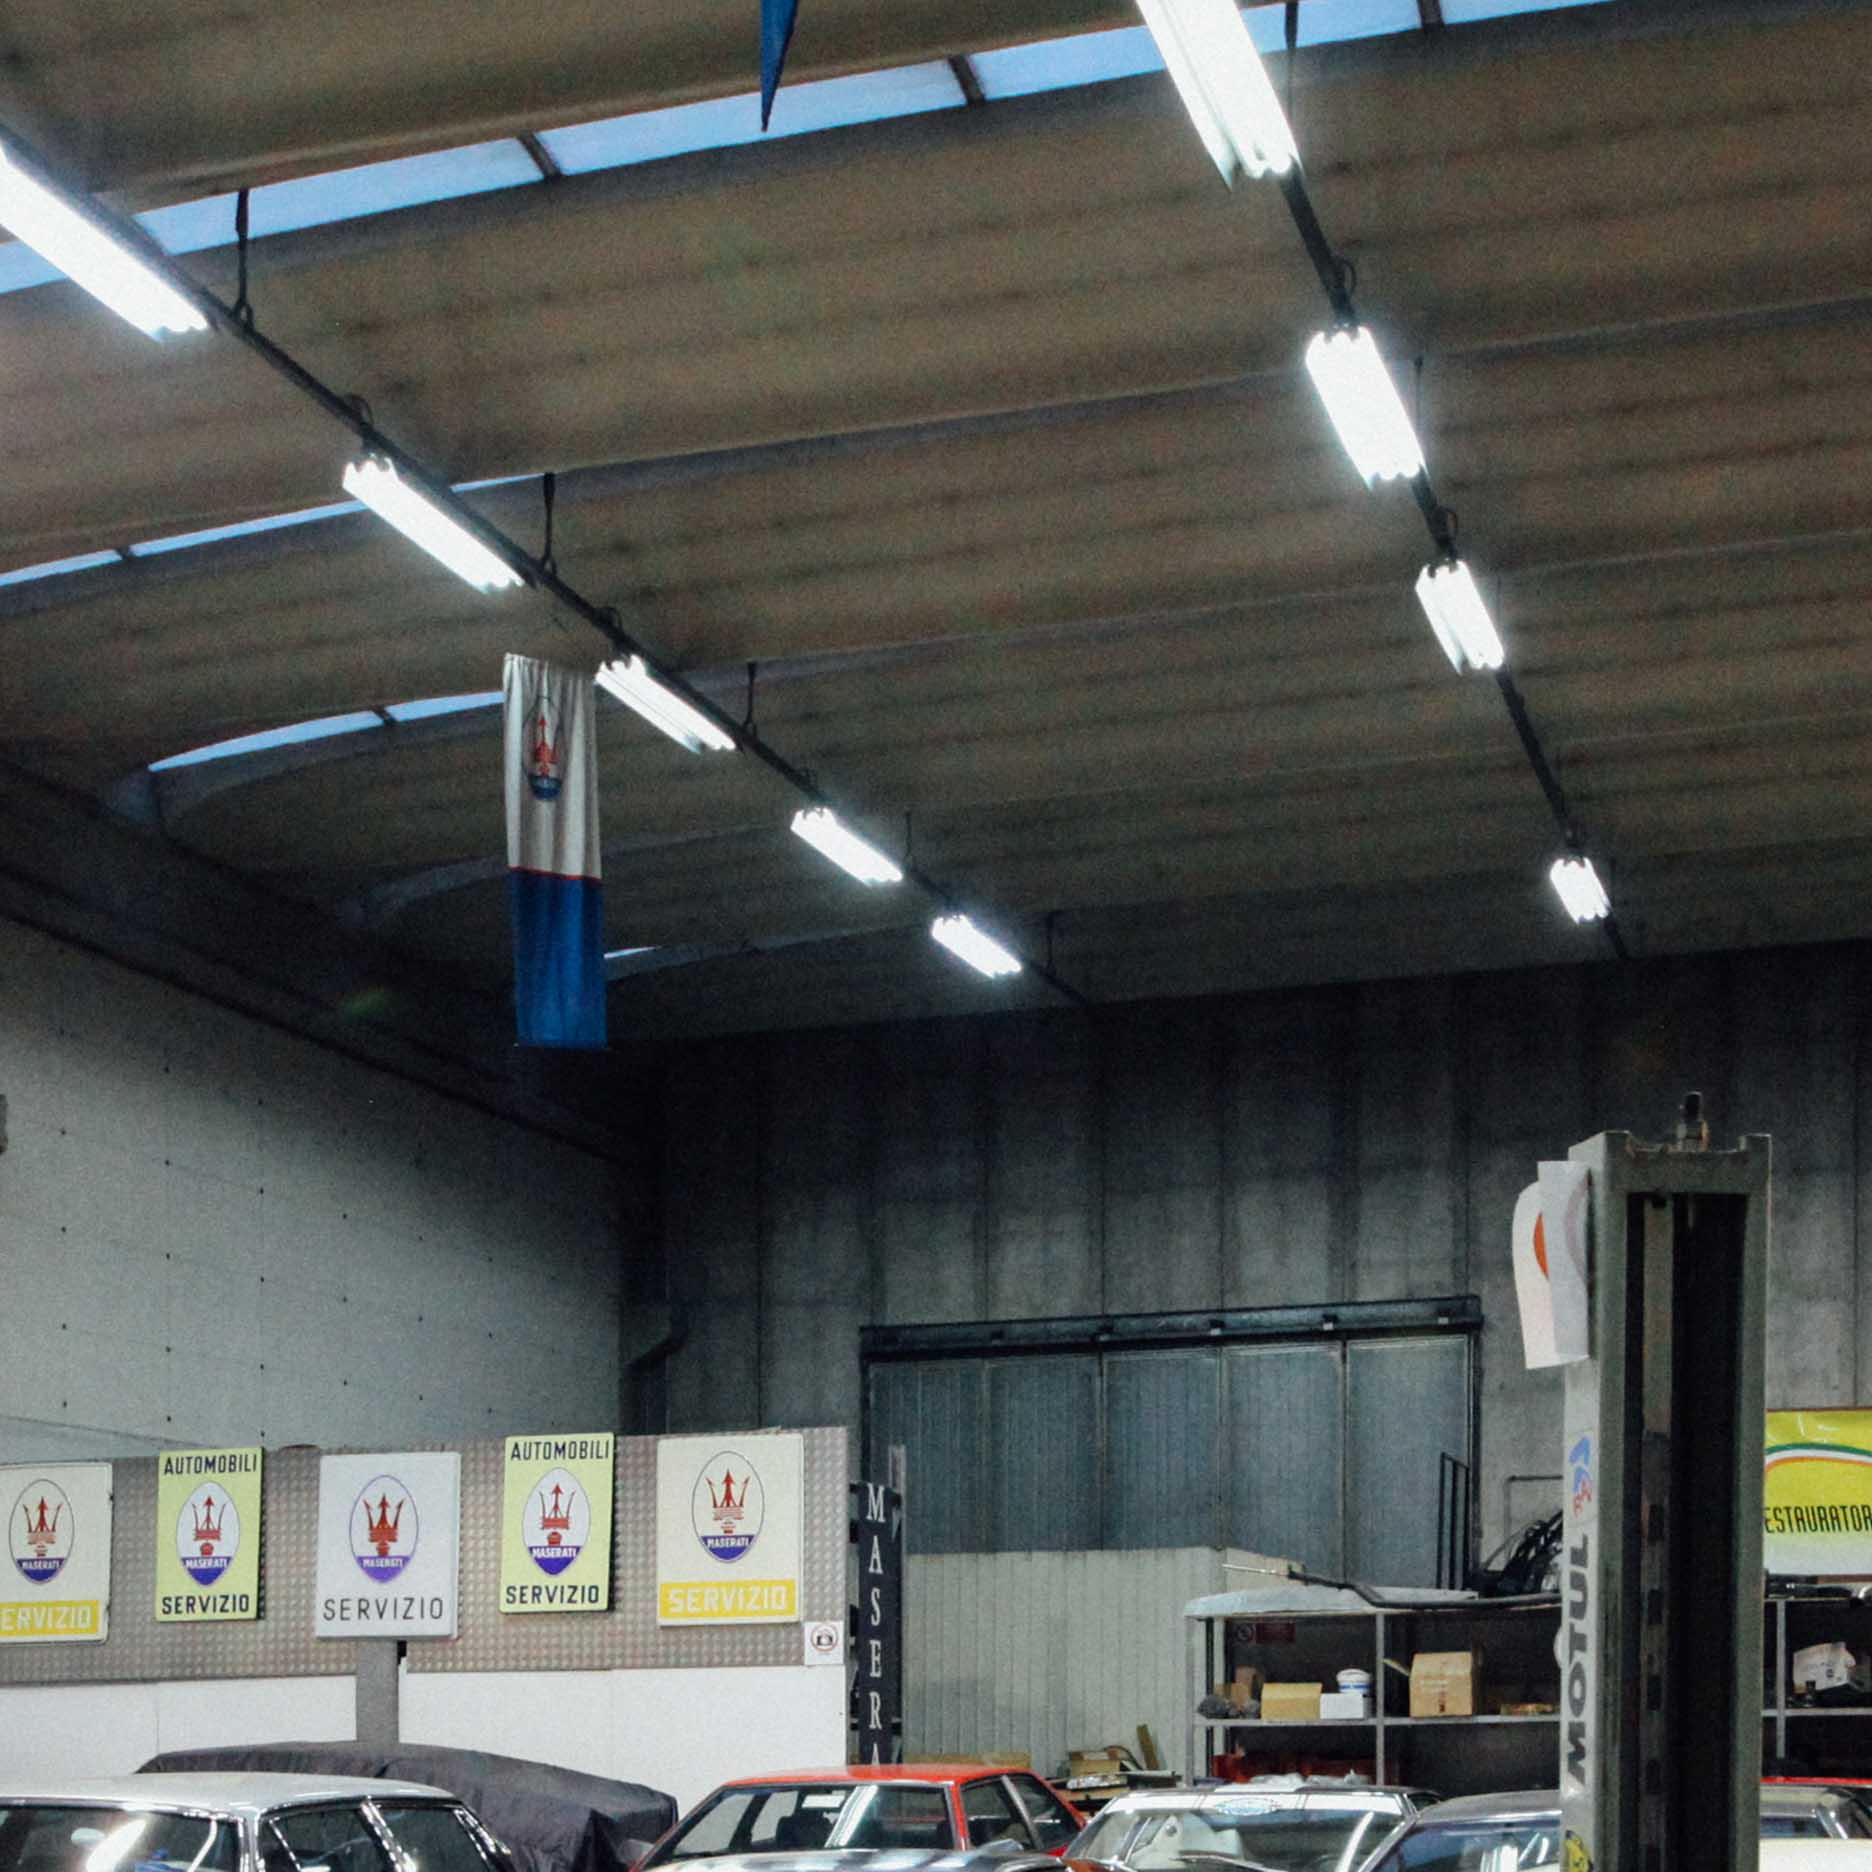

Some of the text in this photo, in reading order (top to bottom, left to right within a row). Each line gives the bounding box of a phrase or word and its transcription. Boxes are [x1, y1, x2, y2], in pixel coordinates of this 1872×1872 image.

[511, 1440, 610, 1461] AUTOMOBILI
[164, 1454, 258, 1475] AUTOMOBILI
[532, 1545, 578, 1559] MASERATI
[706, 1536, 749, 1549] MASERATI
[21, 1557, 61, 1571] MASERATI
[184, 1557, 230, 1570] MASERATI
[362, 1556, 404, 1569] MASERATI
[162, 1594, 250, 1616] SERVIZIO
[505, 1584, 600, 1605] SERVIZIO
[669, 1584, 788, 1614] SERVIZIO
[323, 1597, 444, 1621] SERVIZIO
[1567, 1534, 1589, 1785] MOTUL
